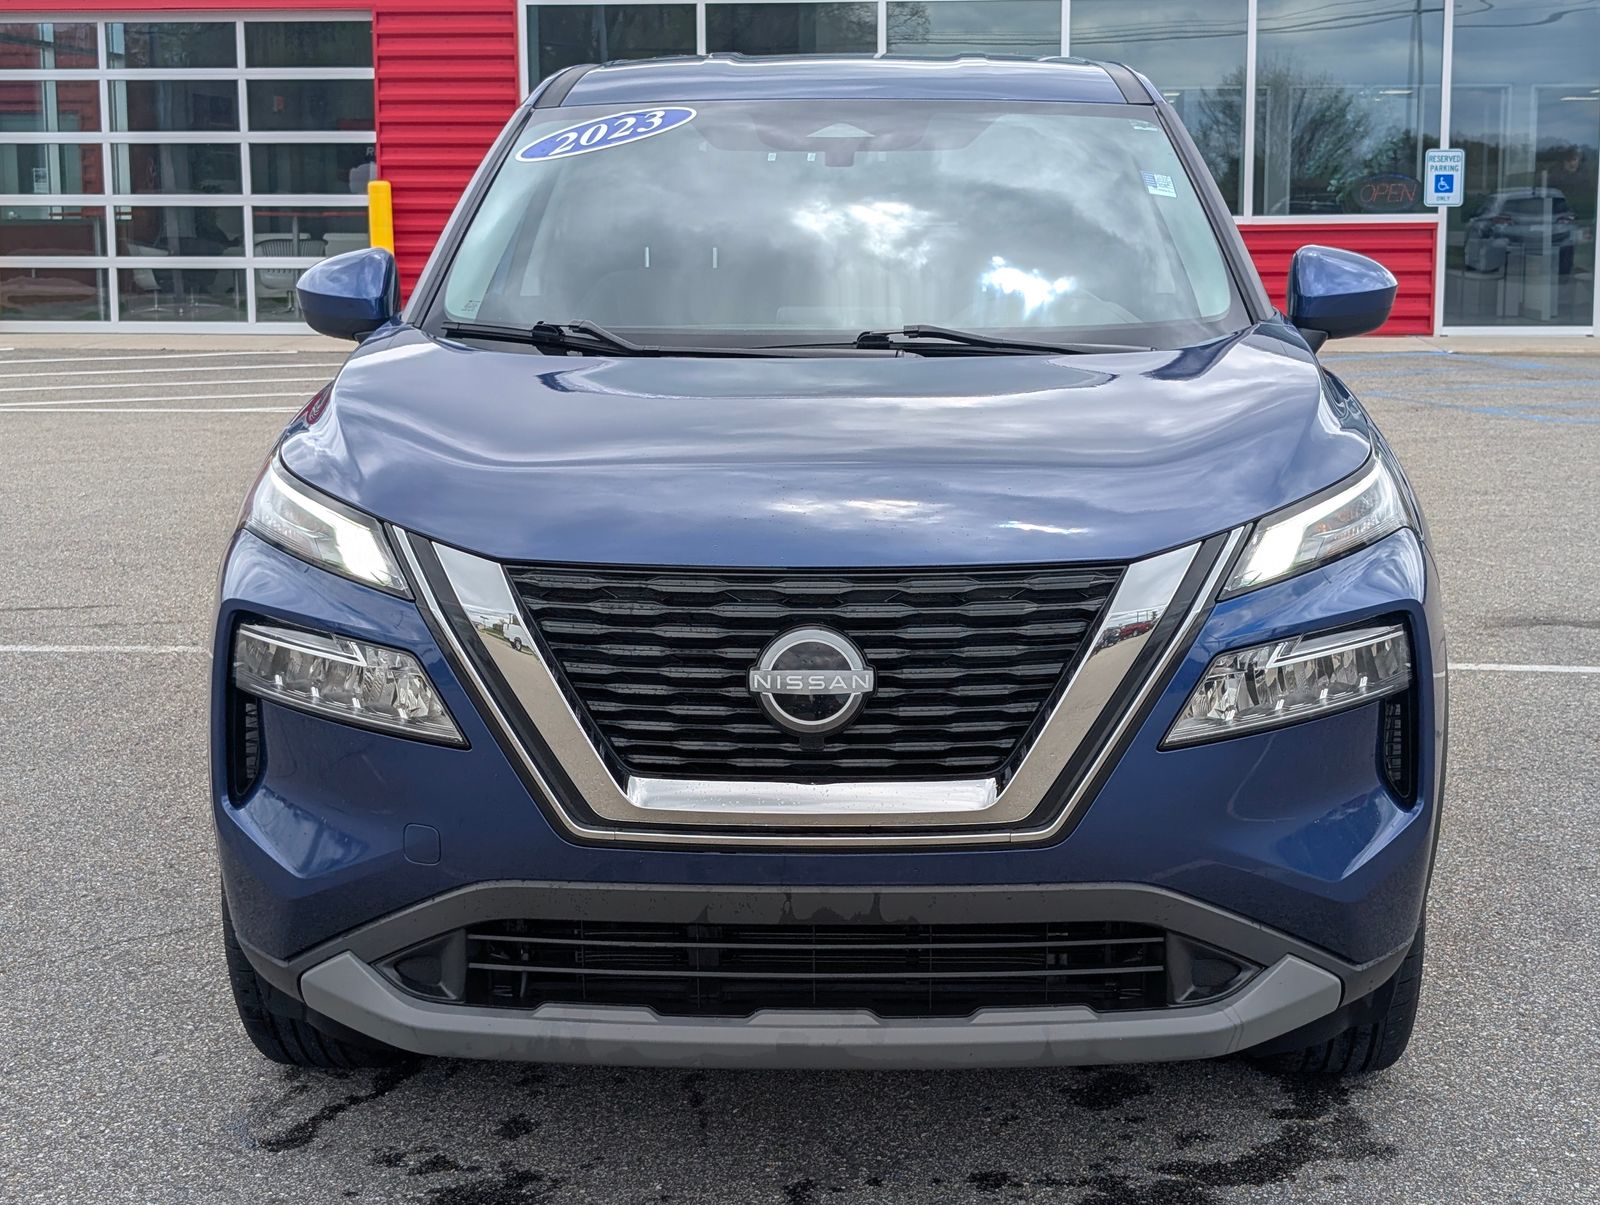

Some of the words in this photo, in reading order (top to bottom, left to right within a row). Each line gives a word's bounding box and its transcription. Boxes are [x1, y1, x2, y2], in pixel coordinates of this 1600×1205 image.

[548, 110, 666, 156] 2023
[1428, 155, 1462, 163] RESERVED
[1430, 164, 1459, 172] PARKING
[1360, 183, 1418, 203] OPEN
[753, 674, 869, 690] NISSAN
